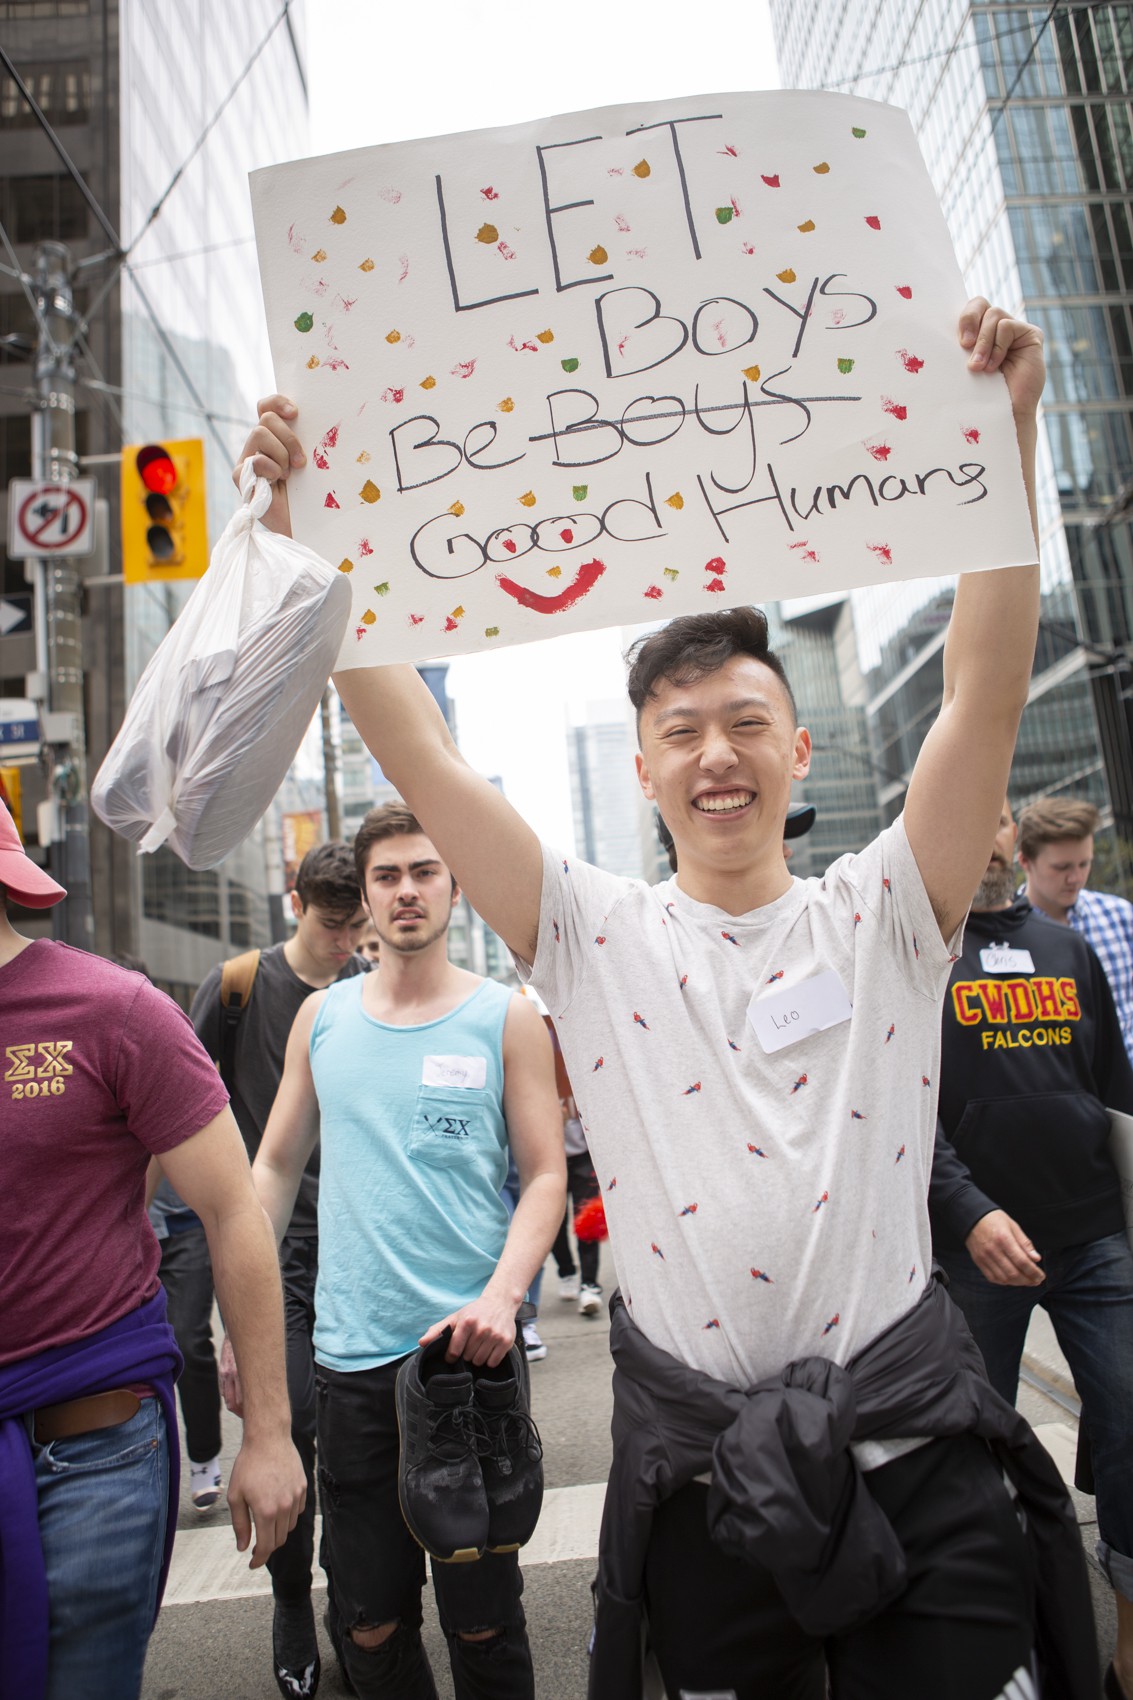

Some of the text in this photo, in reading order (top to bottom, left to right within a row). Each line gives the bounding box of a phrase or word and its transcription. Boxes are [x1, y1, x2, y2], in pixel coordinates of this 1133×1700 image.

[435, 113, 724, 313] LET
[389, 366, 812, 494] Be Boys
[410, 462, 986, 579] Good Humans
[770, 1010, 800, 1030] Leo
[951, 976, 1082, 1026] CWDHS
[981, 1026, 1072, 1050] FALCONS
[11, 1076, 66, 1100] 2016
